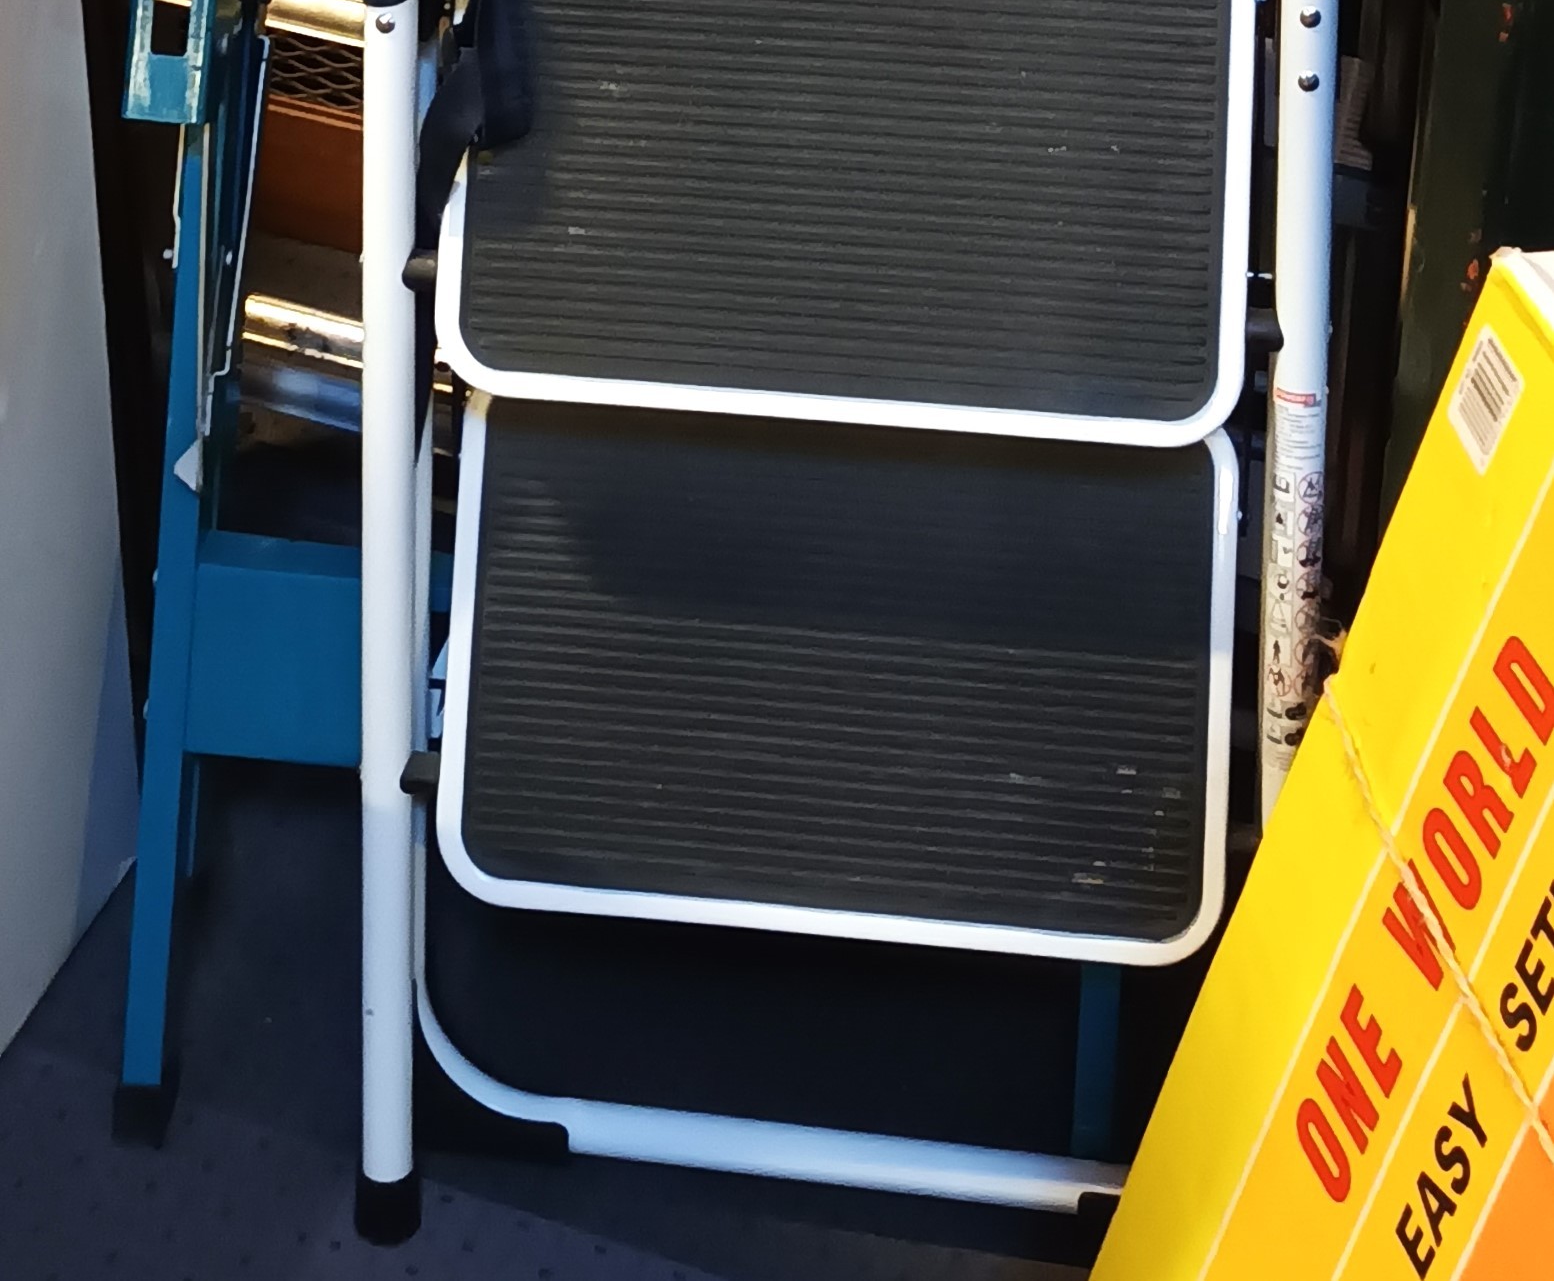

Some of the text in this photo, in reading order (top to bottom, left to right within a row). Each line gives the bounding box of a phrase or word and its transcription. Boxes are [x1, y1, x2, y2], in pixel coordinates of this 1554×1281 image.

[1296, 635, 1554, 1203] ONE WORLD
[1395, 878, 1554, 1281] EASY SET
